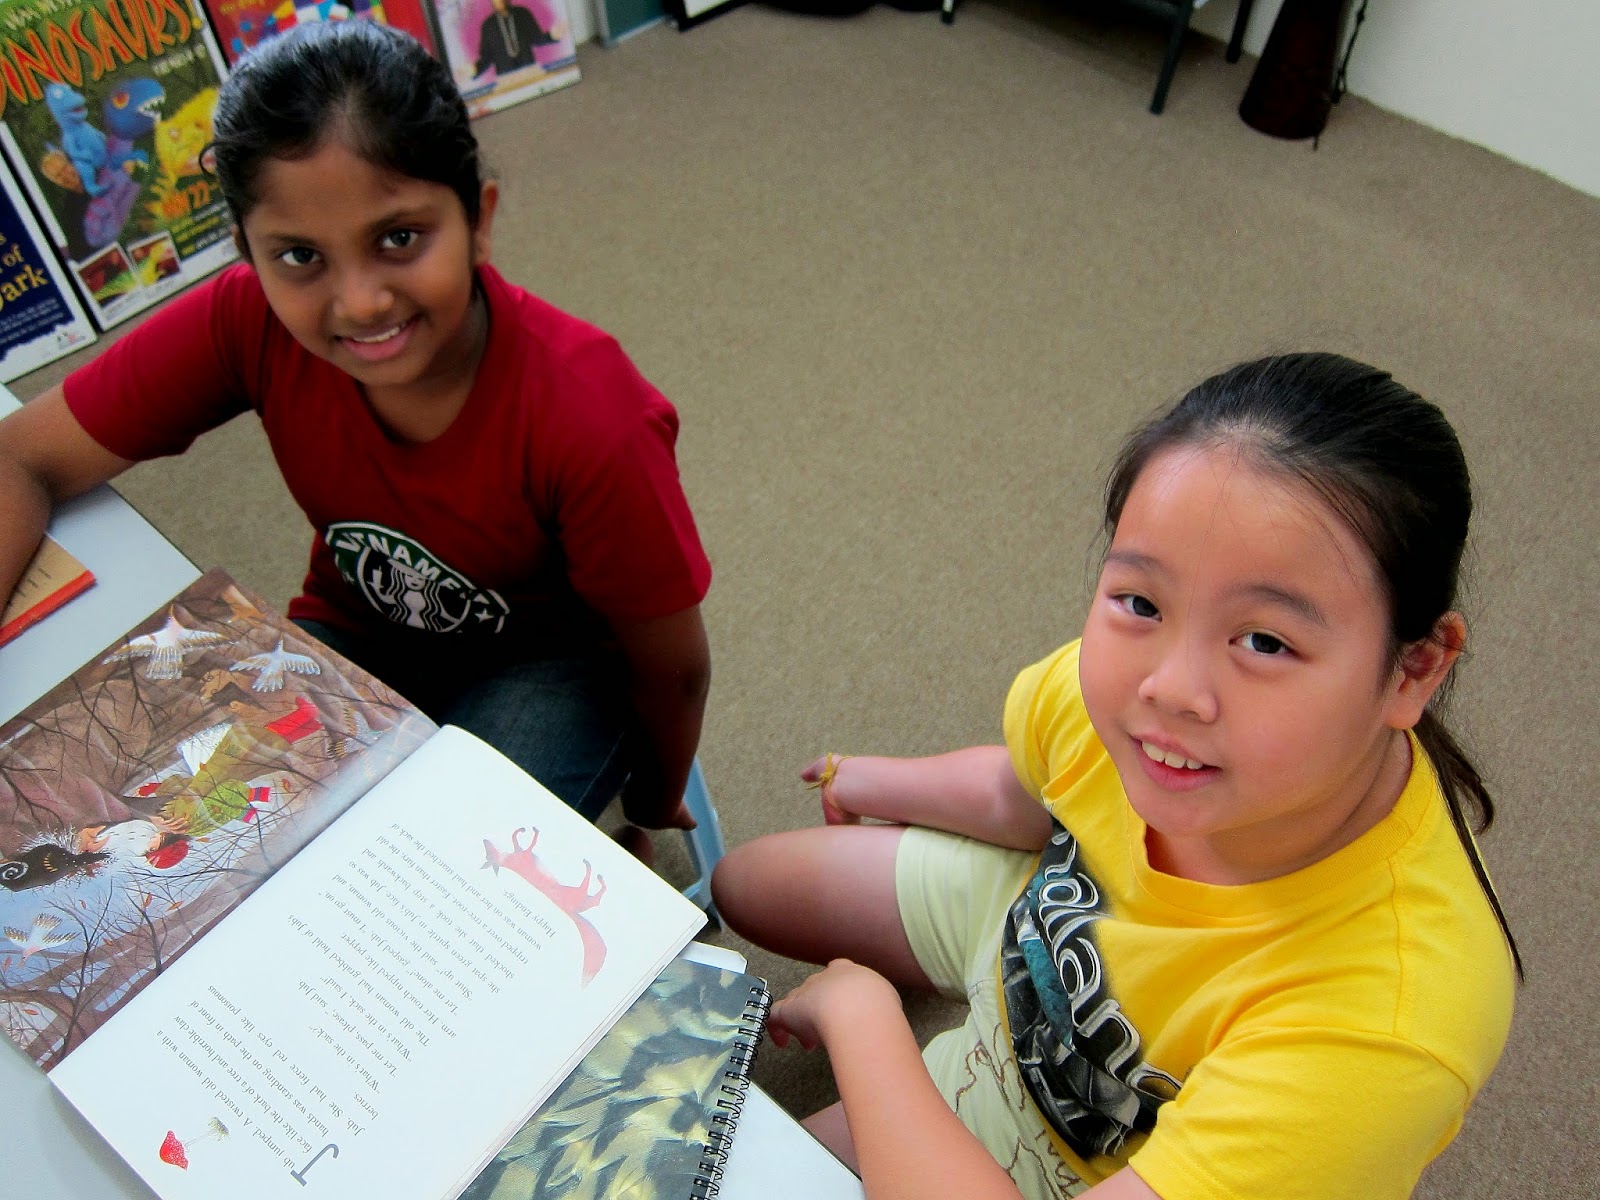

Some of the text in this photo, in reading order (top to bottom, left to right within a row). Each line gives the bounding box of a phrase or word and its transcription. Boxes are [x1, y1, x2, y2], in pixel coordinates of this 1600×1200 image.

[2, 243, 26, 269] of
[0, 264, 48, 312] ark
[374, 834, 390, 846] old
[360, 847, 377, 860] and
[387, 843, 401, 855] the
[348, 860, 358, 869] so
[414, 864, 431, 881] than
[331, 873, 348, 886] and
[356, 867, 370, 880] was
[376, 858, 412, 891] backwards
[368, 878, 387, 893] Jub
[387, 822, 542, 951] woman was on her and had snatched the sack of
[429, 878, 451, 900] Faster
[411, 888, 429, 903] step
[333, 899, 347, 910] go
[369, 906, 386, 919] old
[342, 907, 362, 925] must
[435, 909, 453, 926] took
[302, 928, 314, 938] of
[384, 917, 409, 941] vicious
[417, 920, 428, 931] in
[454, 925, 468, 939] she
[481, 922, 488, 930] a
[531, 914, 557, 939] Happy
[427, 928, 451, 950] spittle
[486, 927, 503, 943] over
[311, 936, 331, 955] hold
[409, 939, 423, 953] the
[468, 938, 485, 954] that
[499, 940, 529, 965] tripped
[364, 954, 380, 971] like
[381, 943, 411, 967] gasped
[419, 950, 439, 966] said
[450, 948, 473, 968] green
[328, 951, 362, 979] grabbed
[483, 952, 515, 979] shocked
[375, 966, 404, 991] nipped
[470, 967, 488, 982] spat
[356, 977, 375, 995] had
[432, 987, 446, 1000] me
[486, 980, 501, 994] she
[206, 984, 242, 1016] poisonous
[309, 992, 329, 1008] said
[339, 991, 348, 1000] I
[402, 988, 425, 1010] touch
[374, 991, 400, 1018] woman
[240, 1016, 256, 1034] like
[364, 1012, 378, 1026] the
[398, 1016, 415, 1030] old
[422, 1008, 440, 1025] Her
[156, 1029, 164, 1037] a
[376, 1023, 387, 1036] in
[414, 1029, 431, 1047] The
[161, 1035, 179, 1053] with
[256, 1031, 273, 1048] eyes
[271, 1048, 288, 1063] red
[332, 1042, 347, 1057] the
[370, 1048, 384, 1061] me
[178, 1050, 203, 1078] woman
[188, 999, 330, 1138] hands was standing on the path in front of
[345, 1054, 356, 1067] in
[288, 1063, 311, 1086] fierce
[173, 1015, 313, 1154] face like the bark of a tree and horrible claw
[200, 1076, 217, 1091] old
[308, 1084, 327, 1103] had
[213, 1089, 244, 1118] twisted
[328, 1101, 344, 1118] She
[242, 1116, 253, 1127] A
